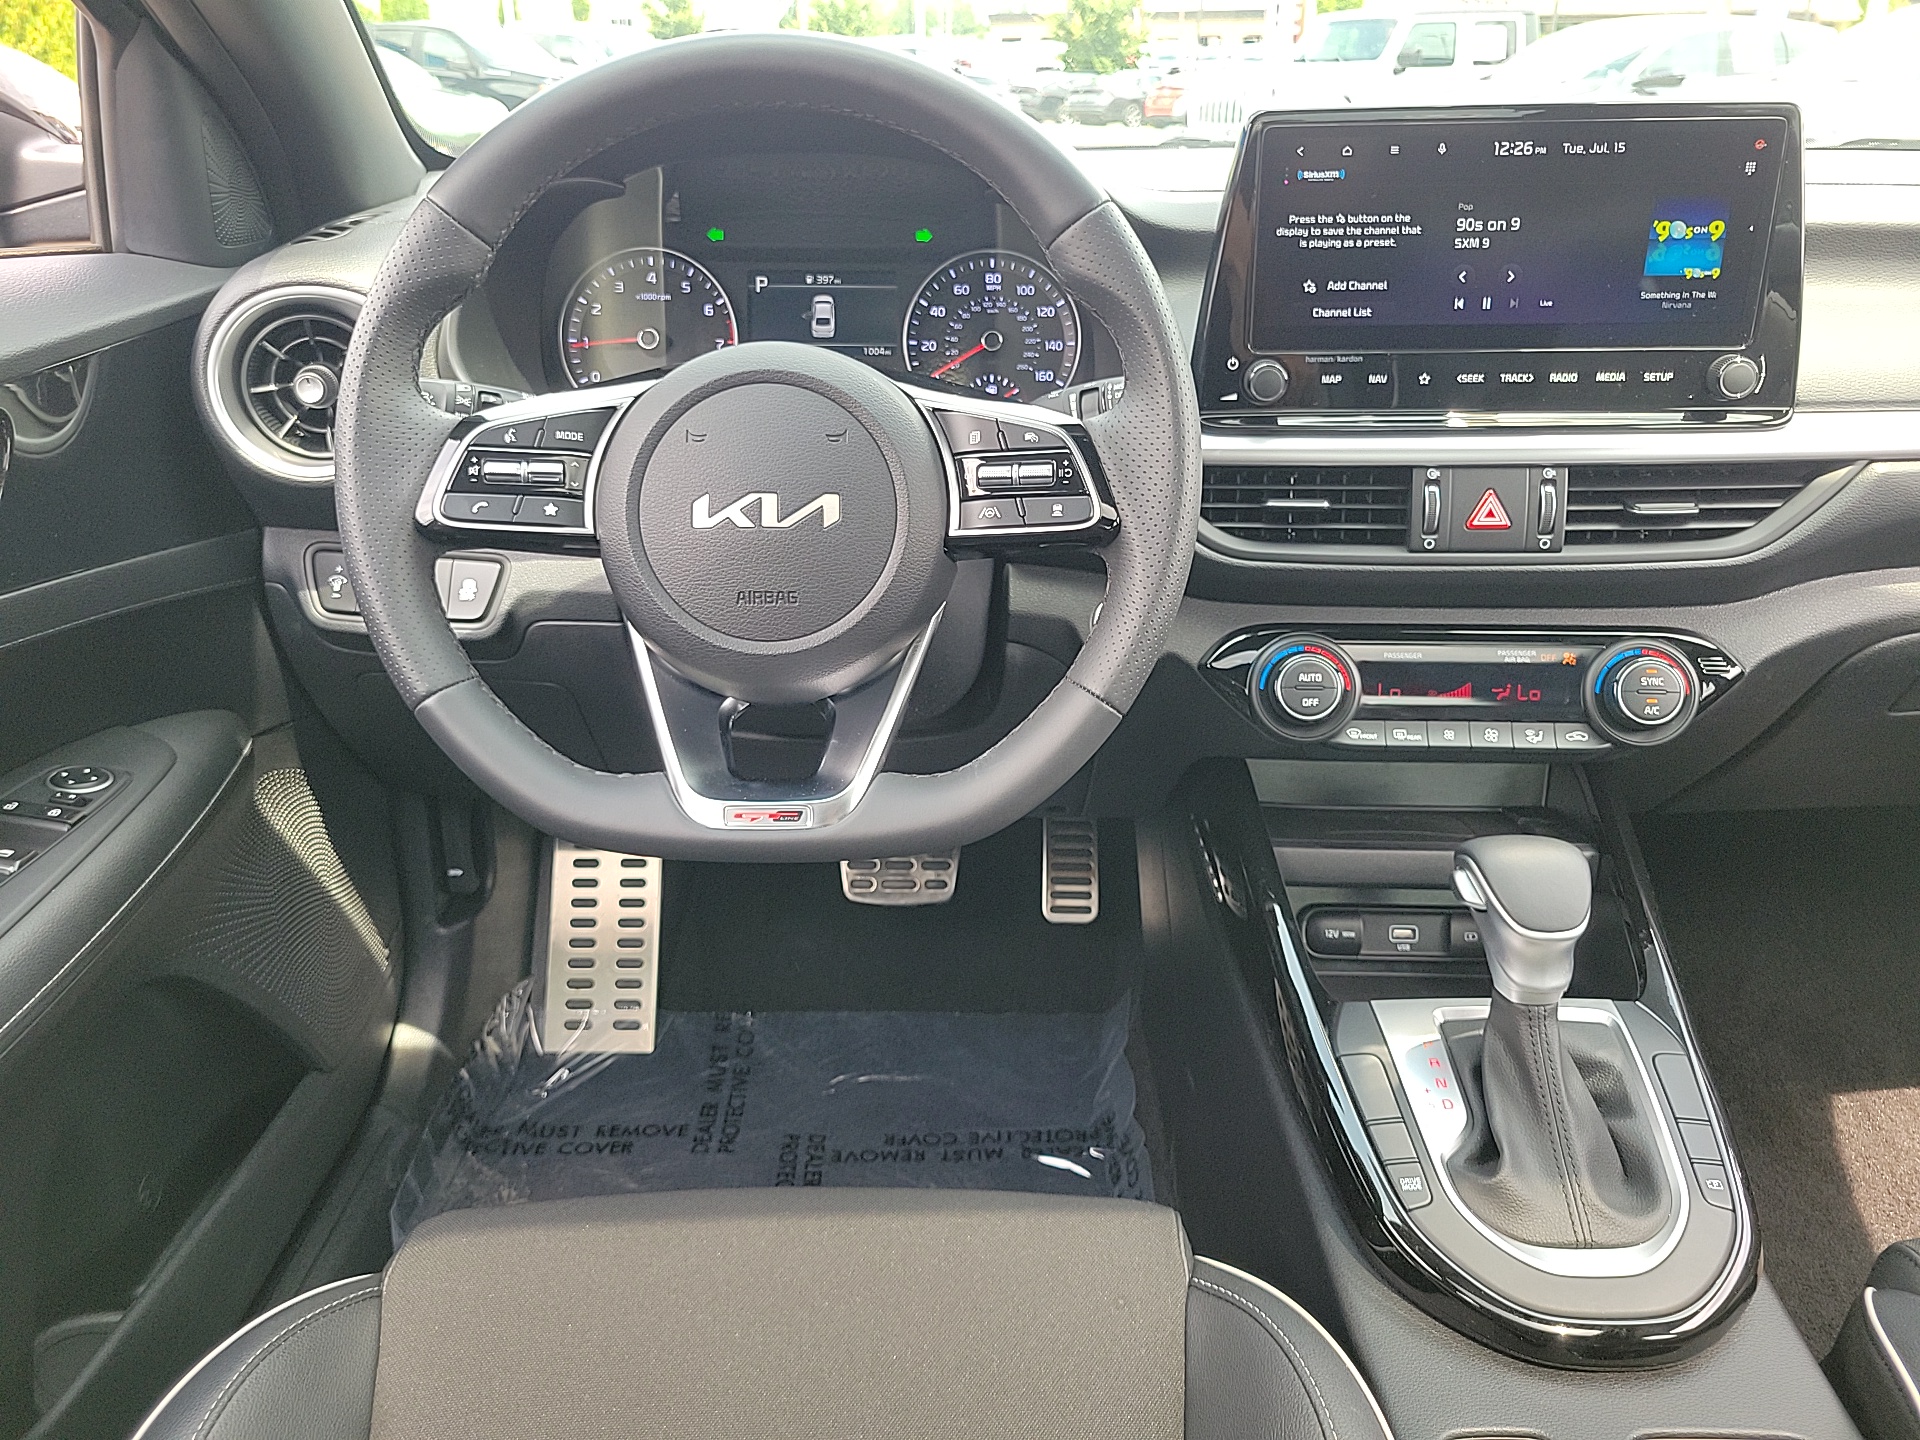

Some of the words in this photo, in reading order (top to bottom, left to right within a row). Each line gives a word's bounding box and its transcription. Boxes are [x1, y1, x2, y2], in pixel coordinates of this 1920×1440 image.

[1494, 141, 1534, 156] 12:26
[1535, 146, 1547, 155] PM
[1614, 141, 1626, 153] 15
[1458, 203, 1474, 212] Pop
[1289, 215, 1316, 224] Press
[1318, 214, 1334, 223] the
[1347, 213, 1380, 223] button
[1381, 214, 1393, 223] on
[1395, 213, 1411, 223] the
[1456, 218, 1484, 232] 90s
[1487, 220, 1507, 231] on
[1510, 217, 1521, 231] 9
[1276, 227, 1309, 237] display
[1311, 227, 1321, 236] to
[1323, 227, 1344, 236] save
[1346, 226, 1362, 235] the
[1364, 226, 1400, 235] channel
[1401, 225, 1422, 235] that
[1299, 239, 1307, 248] is
[1309, 238, 1342, 249] playing
[1343, 239, 1354, 248] as
[1454, 237, 1480, 249] SXM
[1481, 237, 1490, 249] 9
[646, 272, 657, 285] 4
[754, 275, 769, 293] P
[815, 275, 834, 285] 397
[985, 273, 1002, 284] 80
[614, 281, 624, 293] 3
[681, 281, 691, 293] 5
[953, 285, 970, 296] 60
[986, 284, 1002, 292] MPH
[1016, 285, 1035, 296] 100
[1327, 280, 1347, 291] Add
[1349, 280, 1388, 291] Channel
[1640, 291, 1680, 301] Something
[1692, 291, 1706, 299] The
[1539, 299, 1553, 307] Live
[1661, 301, 1692, 309] Nirvana
[591, 304, 602, 316] 2
[703, 304, 714, 316] 6
[929, 307, 946, 318] 40
[1036, 307, 1055, 318] 120
[1312, 308, 1352, 318] Channel
[1353, 307, 1372, 318] List
[715, 339, 725, 350] 7
[920, 340, 937, 352] 20
[1045, 340, 1064, 352] 140
[863, 347, 884, 356] 1004
[590, 371, 600, 383] 0
[1034, 371, 1054, 382] 160
[1321, 374, 1342, 384] MAP
[1368, 374, 1388, 384] NAV
[1549, 372, 1579, 383] RADIO
[1595, 372, 1626, 382] MEDIA
[1643, 372, 1674, 382] SETUP
[555, 431, 584, 441] MODE
[691, 492, 841, 529] KIA
[736, 590, 799, 606] AIRBAG
[1384, 652, 1423, 660] PASSENGER
[1540, 654, 1557, 662] OFF
[1298, 673, 1323, 682] AUTO
[1640, 677, 1665, 686] SYNC
[1517, 684, 1541, 701] Lo
[1302, 698, 1319, 707] OFF
[1643, 706, 1660, 715] A/C
[1324, 929, 1340, 939] 12V
[1435, 1077, 1448, 1089] N
[1442, 1098, 1454, 1110] D
[518, 1121, 581, 1139] MUST
[596, 1123, 690, 1139] REMOVE
[883, 1132, 958, 1149] COVER
[557, 1140, 634, 1156] COVER
[832, 1149, 926, 1164] REMOVE
[940, 1147, 1004, 1163] MUST
